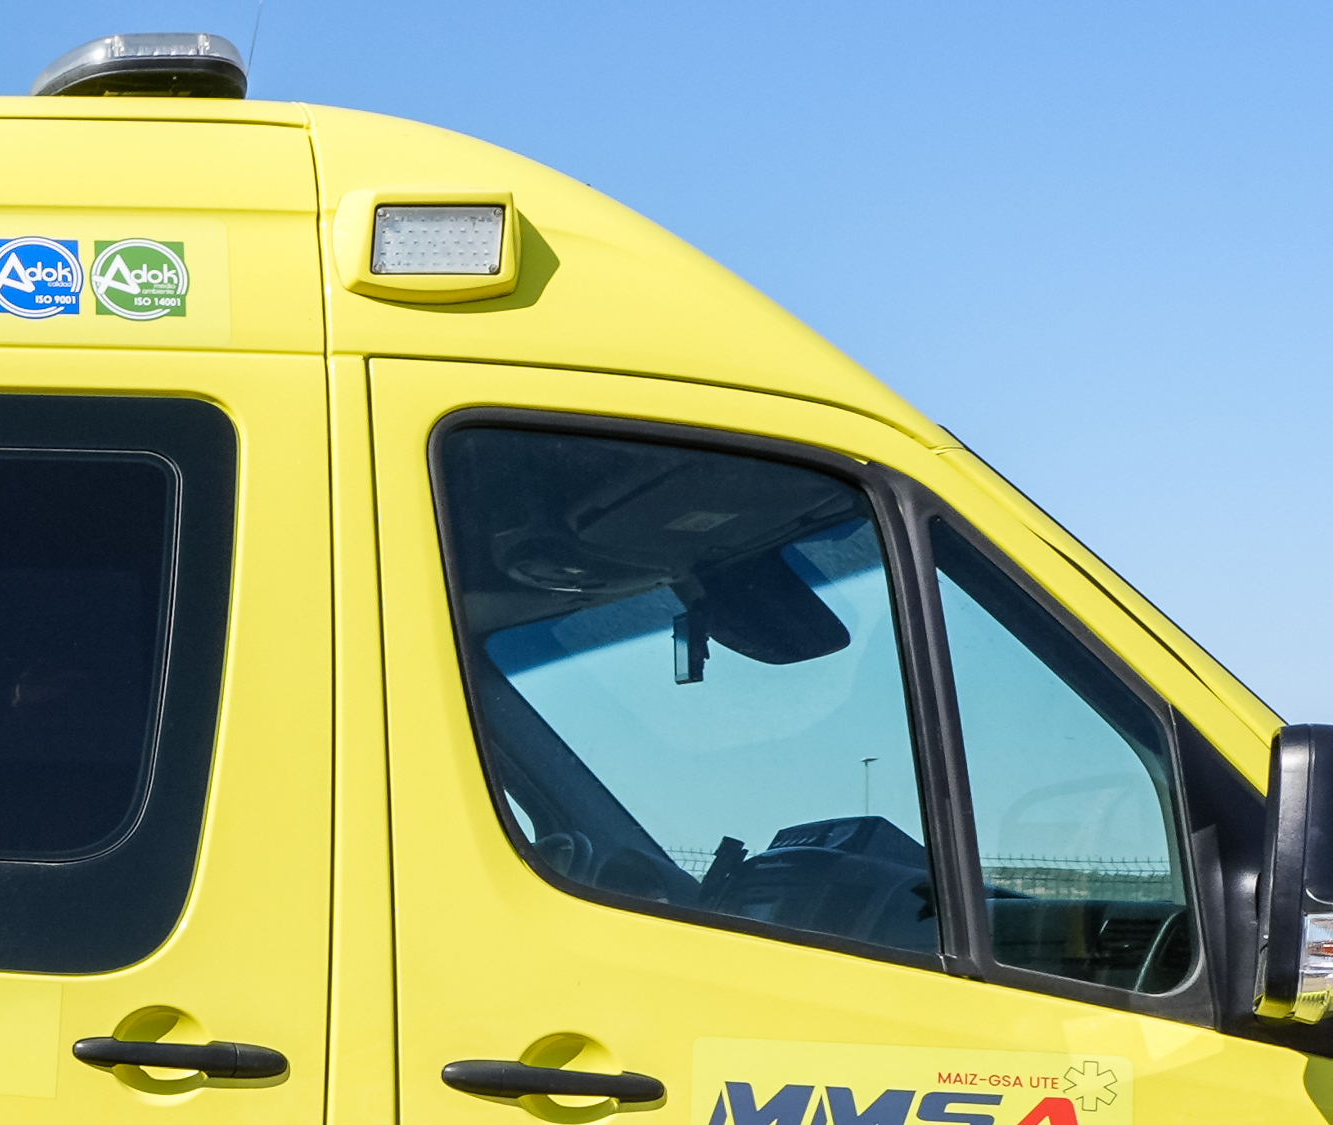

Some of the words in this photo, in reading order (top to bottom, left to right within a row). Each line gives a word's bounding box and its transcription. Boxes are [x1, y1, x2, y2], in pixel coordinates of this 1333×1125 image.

[92, 254, 178, 295] Adok
[35, 295, 53, 304] ISO
[54, 295, 76, 304] 9001
[134, 297, 152, 306] ISO
[154, 297, 181, 307] 14001
[937, 1071, 1023, 1089] MAIZ-GSA
[1028, 1075, 1060, 1090] UTE
